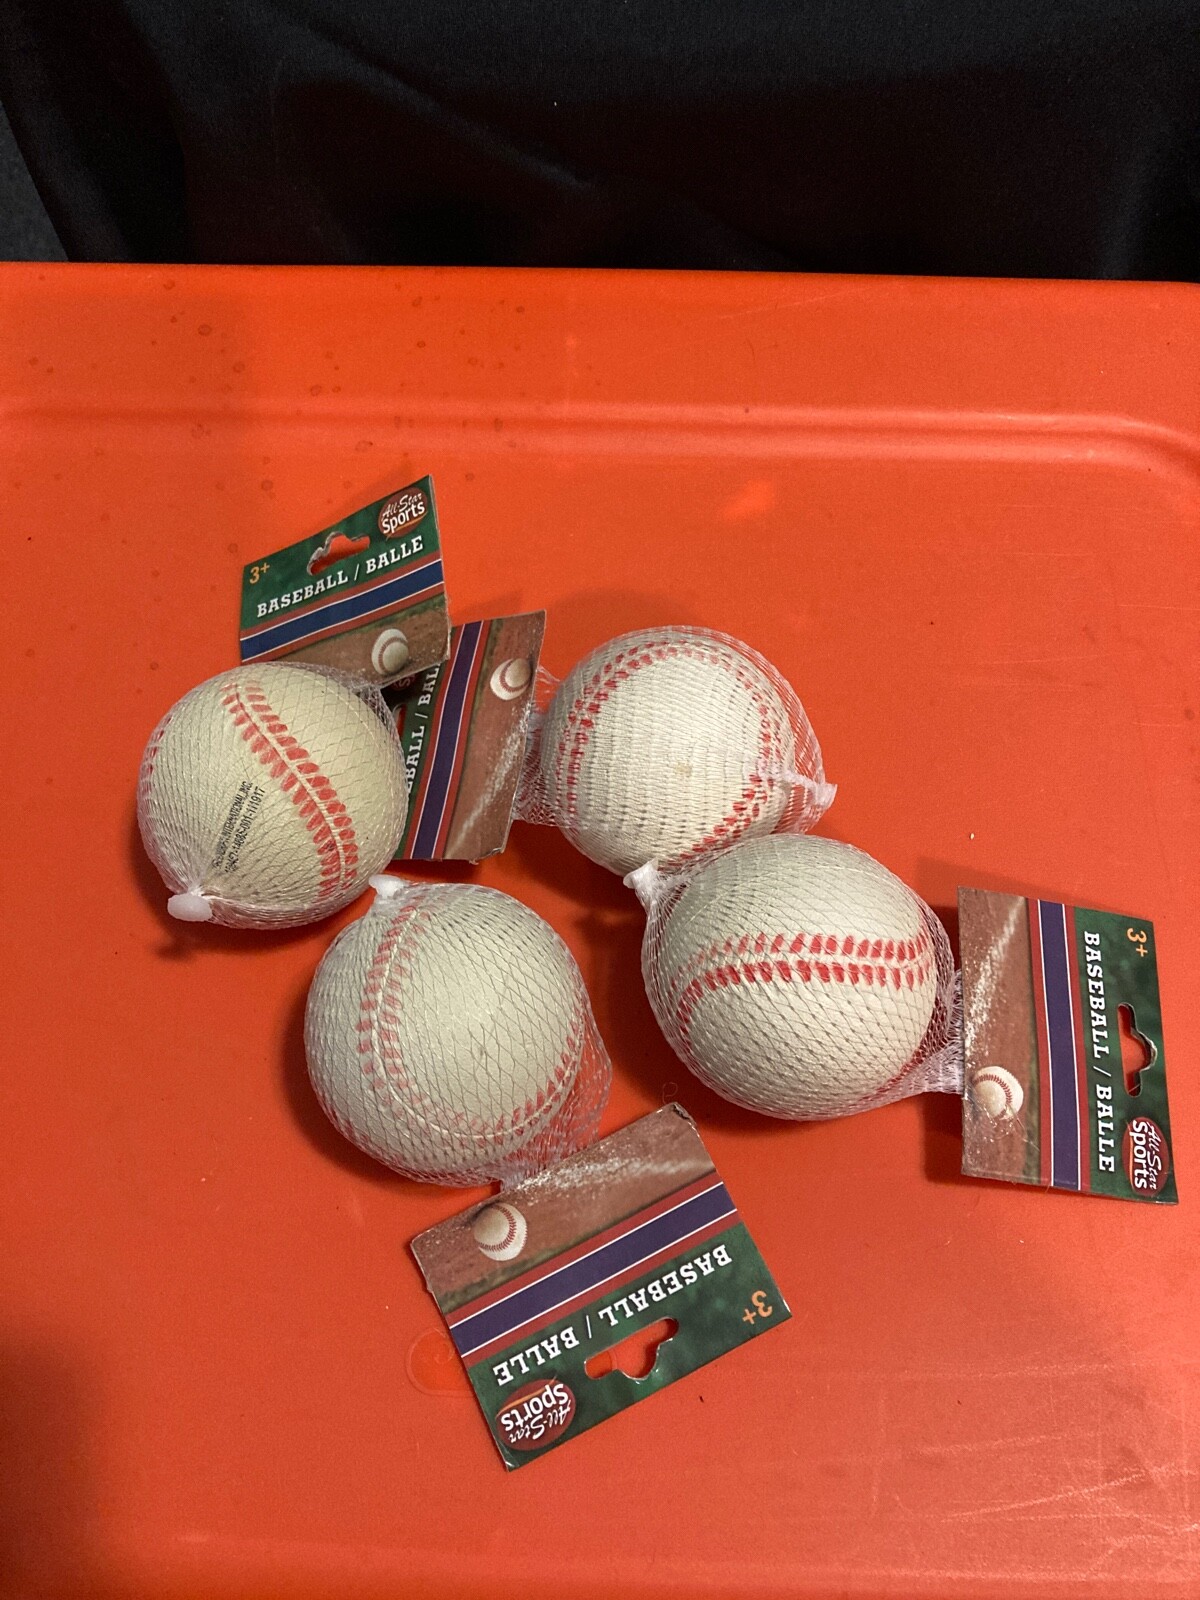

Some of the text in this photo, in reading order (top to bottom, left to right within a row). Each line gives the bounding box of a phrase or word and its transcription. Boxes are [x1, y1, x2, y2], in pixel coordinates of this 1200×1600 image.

[381, 492, 423, 521] All-Star
[381, 501, 425, 535] Sports
[249, 562, 270, 585] 3+
[256, 535, 424, 618] BASEBALL / BALLE
[406, 725, 425, 795] EBALL
[417, 662, 440, 706] BAL
[1126, 927, 1148, 957] 3+
[1084, 930, 1115, 1172] BASEBALL / BALLE
[1129, 1119, 1148, 1189] Sports
[1147, 1121, 1161, 1190] All-Star
[492, 1244, 733, 1386] BASEBALL / BALLE
[742, 1290, 773, 1325] 3+
[500, 1383, 570, 1431] Sports
[508, 1398, 572, 1444] All-Star
